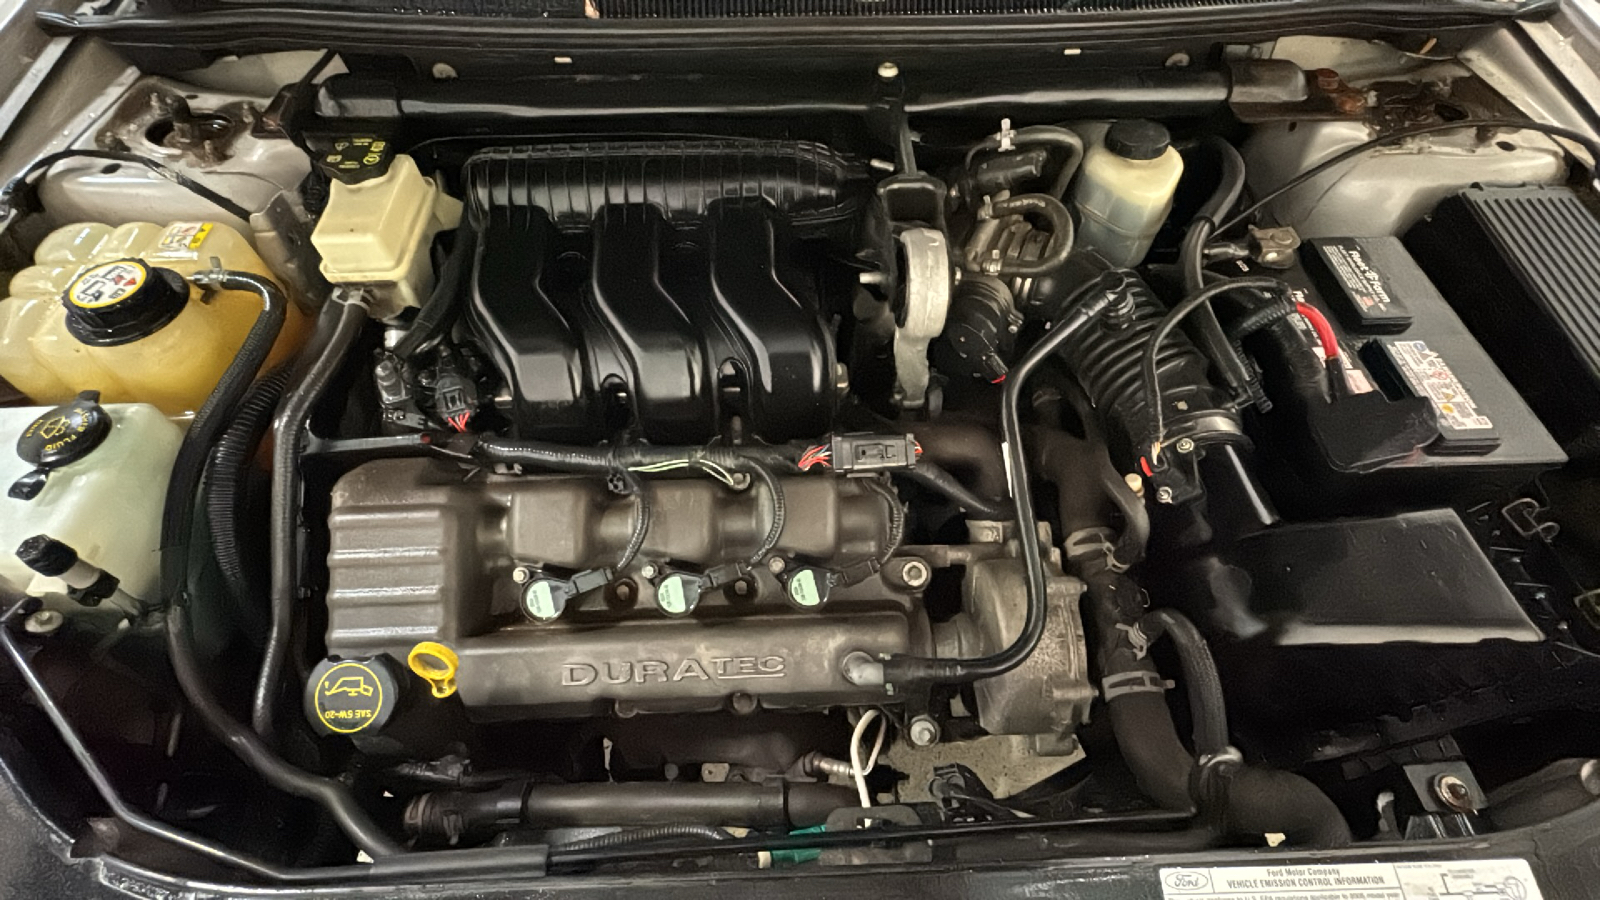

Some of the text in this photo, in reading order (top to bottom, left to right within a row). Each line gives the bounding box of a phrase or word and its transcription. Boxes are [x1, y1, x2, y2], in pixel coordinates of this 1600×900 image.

[1370, 281, 1391, 302] Farm
[45, 434, 77, 451] FLUID
[562, 656, 786, 686] DURATEC
[324, 709, 372, 719] SAE 5W-20
[1266, 867, 1340, 877] Ford Motor Company
[1174, 873, 1200, 887] Ford
[1226, 876, 1386, 889] VEHICLE EMISSION CONTROL INFORMATION
